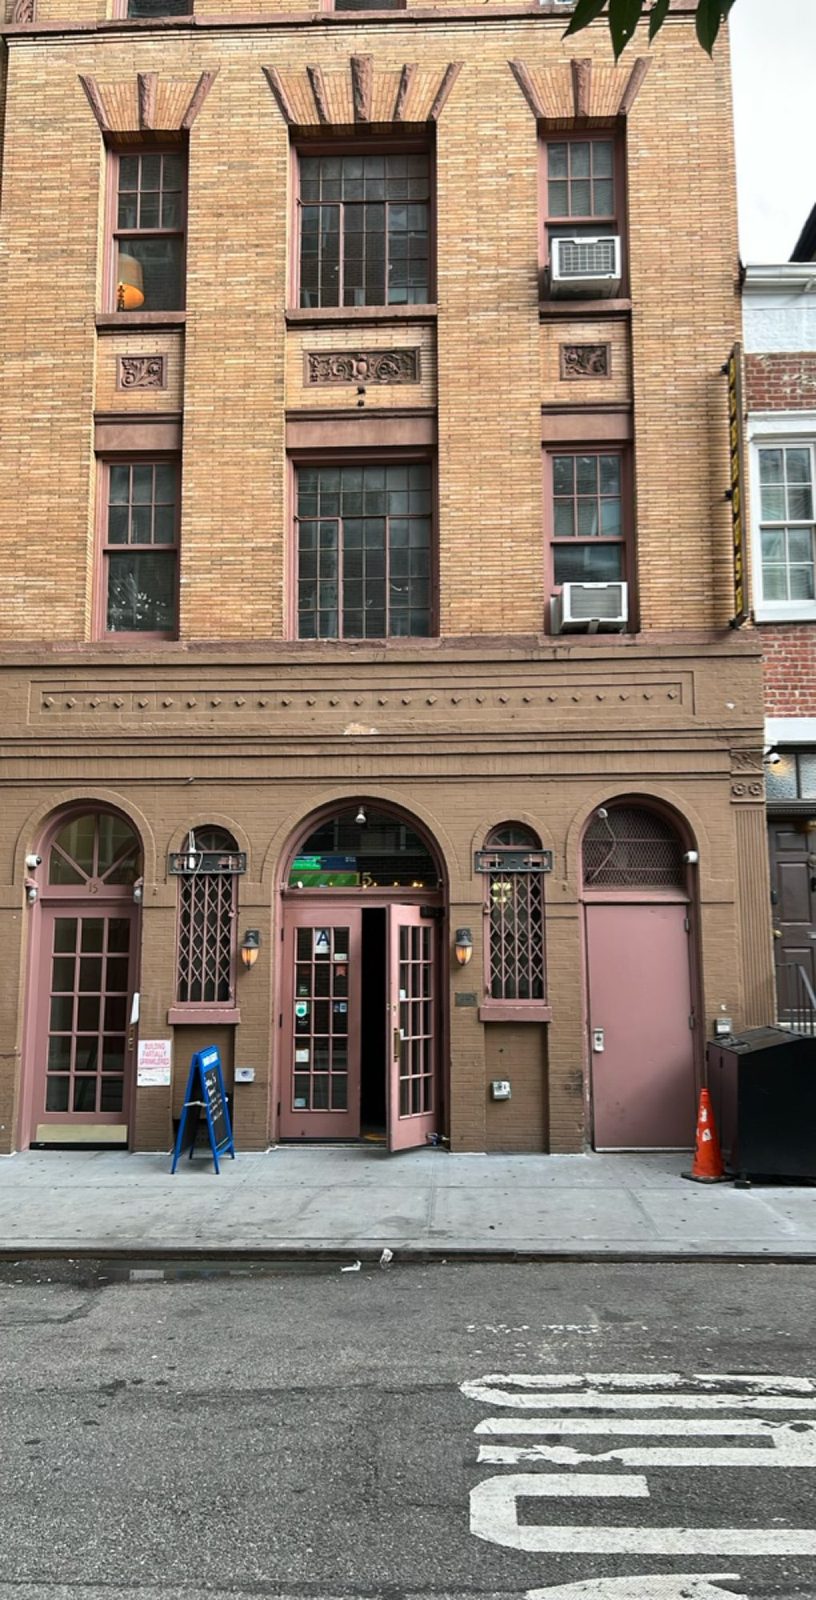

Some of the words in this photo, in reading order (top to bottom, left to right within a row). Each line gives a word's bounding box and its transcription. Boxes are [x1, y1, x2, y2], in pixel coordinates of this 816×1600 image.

[355, 872, 373, 886] 15
[88, 882, 98, 894] 15
[316, 930, 330, 946] A
[144, 1042, 165, 1050] BUILDING
